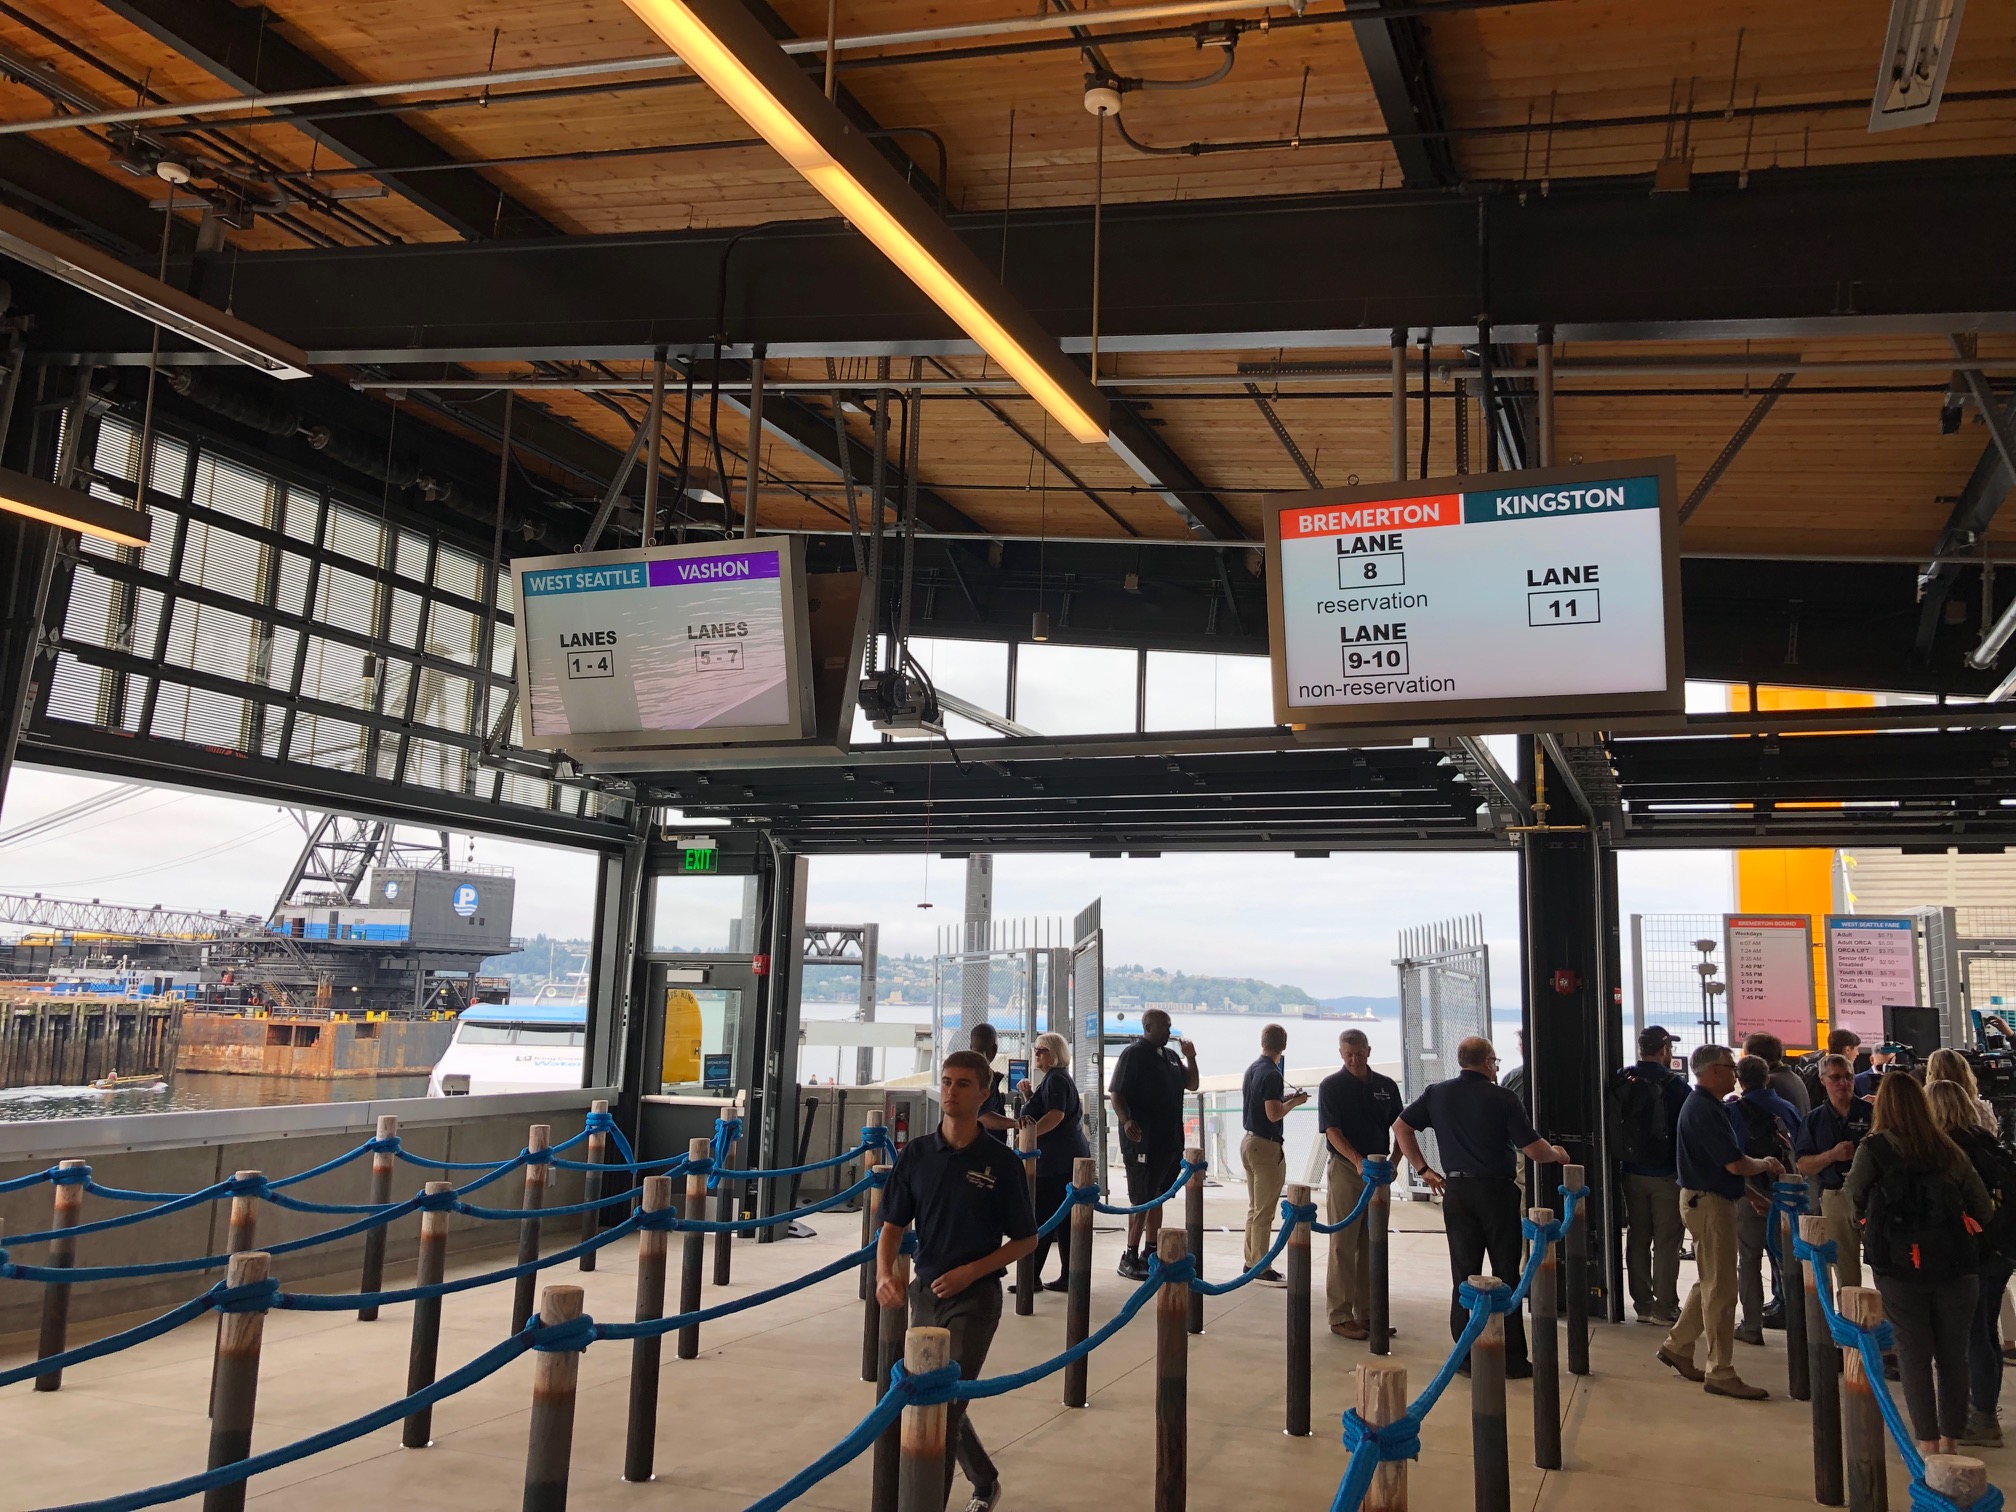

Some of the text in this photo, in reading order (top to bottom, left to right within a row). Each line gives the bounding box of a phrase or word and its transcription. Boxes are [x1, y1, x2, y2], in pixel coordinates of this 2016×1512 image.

[1495, 486, 1625, 516] KINGSTON
[1298, 503, 1440, 533] BREMERTON
[1335, 533, 1403, 555] LANE
[677, 560, 750, 580] VASHON
[1362, 562, 1378, 581] 8
[1527, 565, 1600, 587] LANE
[529, 569, 640, 592] WEST SEATTLE
[1316, 592, 1429, 614] reservation
[1548, 600, 1578, 618] 11
[560, 630, 617, 648] LANES
[687, 621, 749, 640] LANES
[1340, 623, 1407, 643] LANE
[1348, 650, 1402, 670] 9-10
[1298, 676, 1456, 699] non-reservation
[685, 849, 712, 870] EXIT
[459, 888, 476, 906] P
